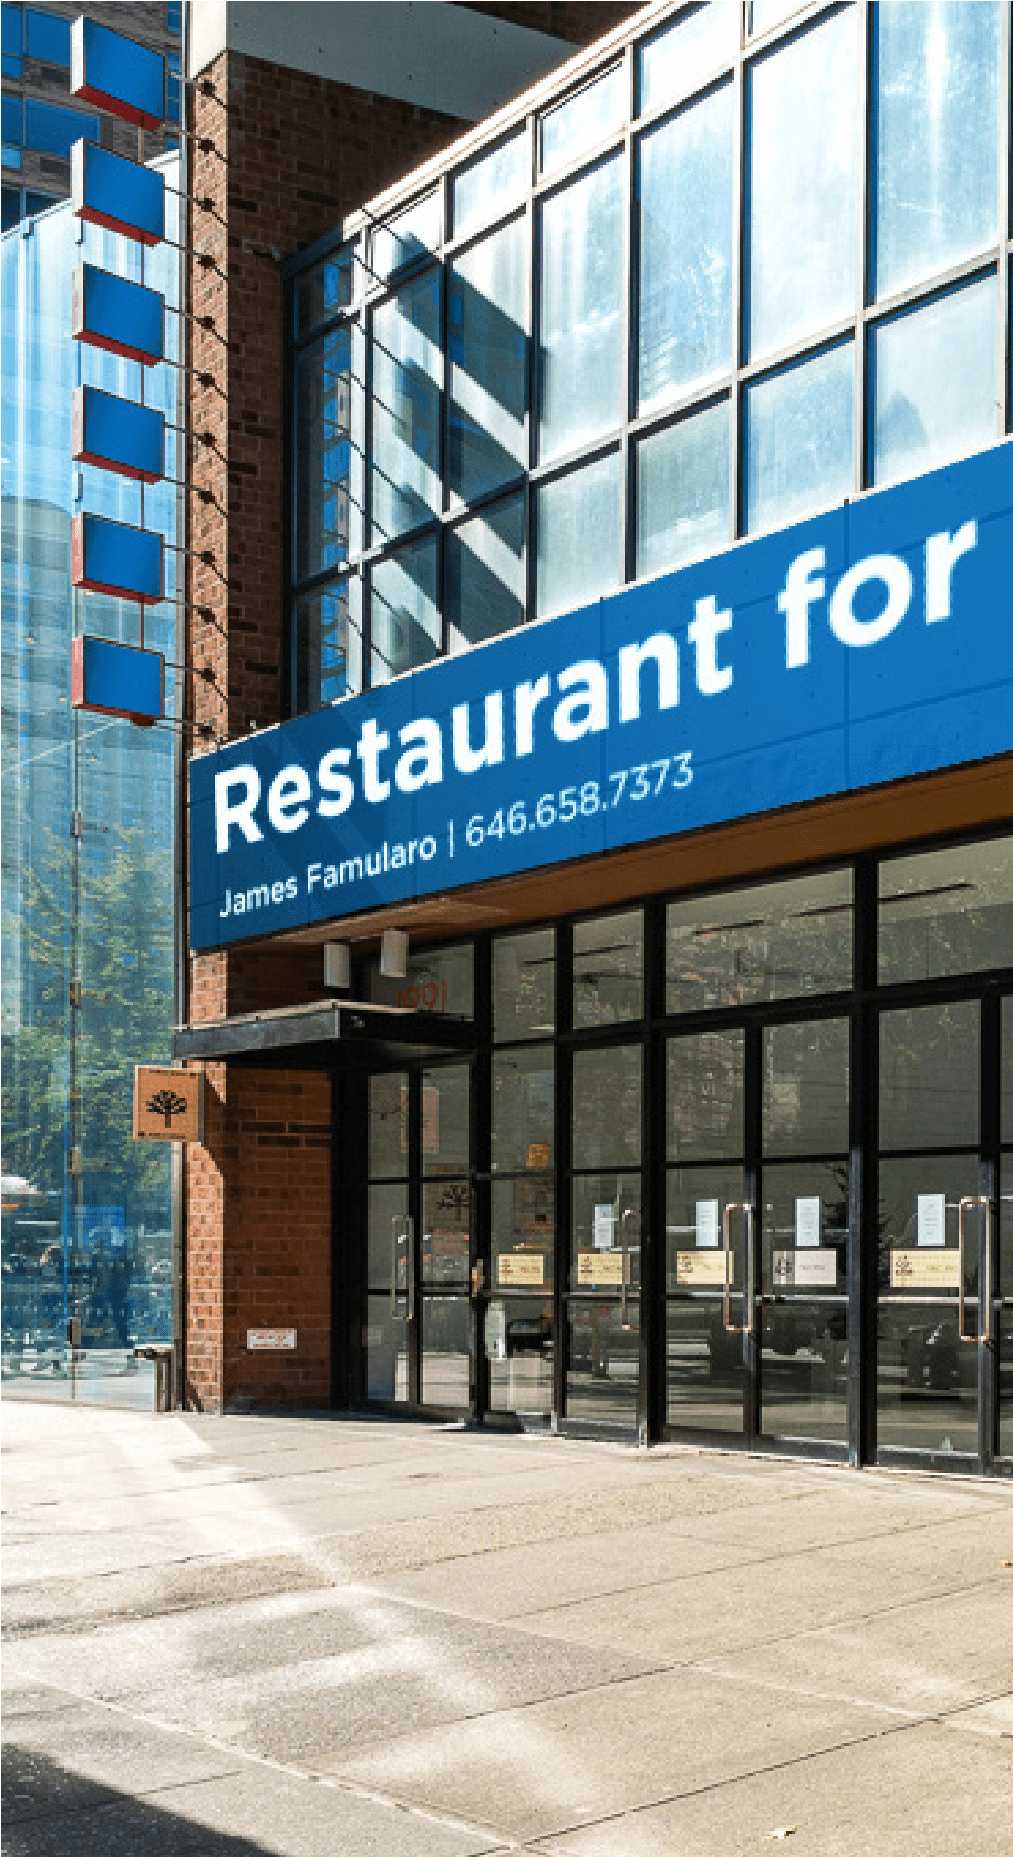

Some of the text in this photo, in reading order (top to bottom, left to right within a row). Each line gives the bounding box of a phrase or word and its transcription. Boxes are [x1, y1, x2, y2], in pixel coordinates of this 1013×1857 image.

[213, 594, 734, 854] Restaurant
[777, 520, 977, 669] for
[219, 875, 298, 918] James
[307, 837, 437, 894] Famularo
[465, 751, 694, 847] 646.658.7373
